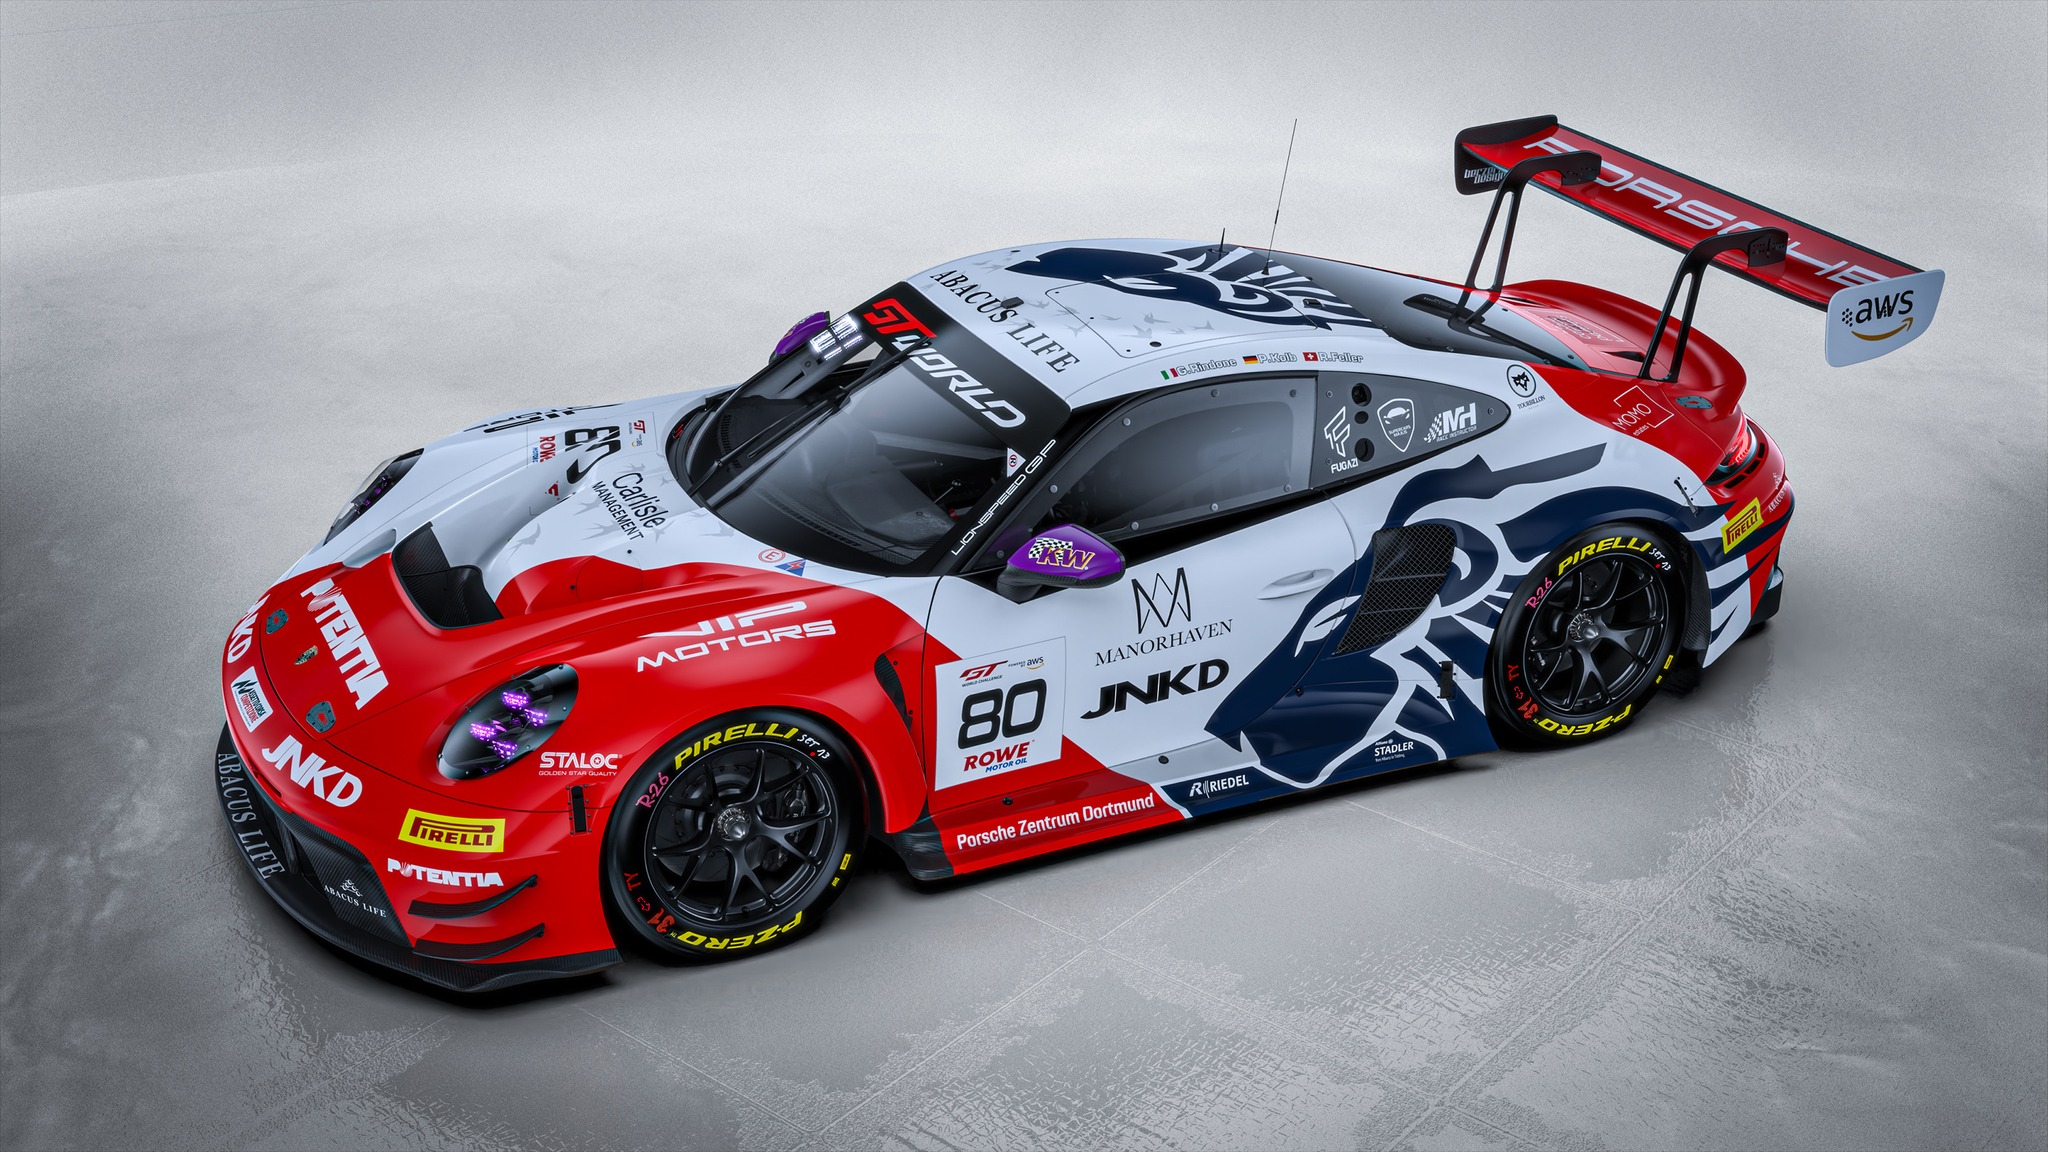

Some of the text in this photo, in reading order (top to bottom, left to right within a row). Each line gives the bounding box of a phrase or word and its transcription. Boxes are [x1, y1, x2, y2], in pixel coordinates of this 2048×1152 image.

[863, 298, 938, 339] GT
[930, 270, 1081, 373] ABACUS LIFE
[1856, 290, 1914, 324] aws
[891, 335, 1027, 428] WORLD
[1517, 394, 1546, 410] TOURBILLON
[1612, 402, 1652, 431] MOMO
[1331, 458, 1359, 474] FUGAZI
[592, 480, 644, 540] MANAGEMENT
[612, 472, 669, 528] Carlisle
[951, 439, 1056, 556] LIONSPEED GP
[1726, 505, 1758, 546] PIRELLI
[1557, 537, 1652, 577] PIRELLI
[1649, 547, 1666, 560] SET
[227, 593, 271, 664] NKD
[637, 601, 808, 639] VIP
[300, 577, 389, 711] POTENTIA
[637, 619, 837, 673] MOTORS
[1095, 619, 1233, 666] MANORHAVEN
[959, 660, 1009, 681] GT
[1026, 656, 1044, 667] aws
[979, 674, 1003, 684] CHALLENGE
[1080, 659, 1230, 719] JNKD
[957, 678, 1048, 749] 80
[540, 751, 618, 769] STALOC
[674, 722, 799, 771] PIRELLI
[797, 734, 821, 748] SET
[963, 741, 1031, 772] ROWE
[1374, 741, 1414, 757] STADLER
[261, 735, 363, 808] JNKD
[985, 757, 1028, 773] MOTOR OIL
[1210, 774, 1250, 793] RIEDEL
[218, 753, 257, 824] ABACUS
[238, 829, 286, 880] LIFE
[409, 816, 496, 847] PIRELLI
[957, 793, 1155, 850] Porsche Zentrum Dortmund
[387, 857, 505, 888] POTENTIA
[324, 885, 387, 918] ABACUS LIFE
